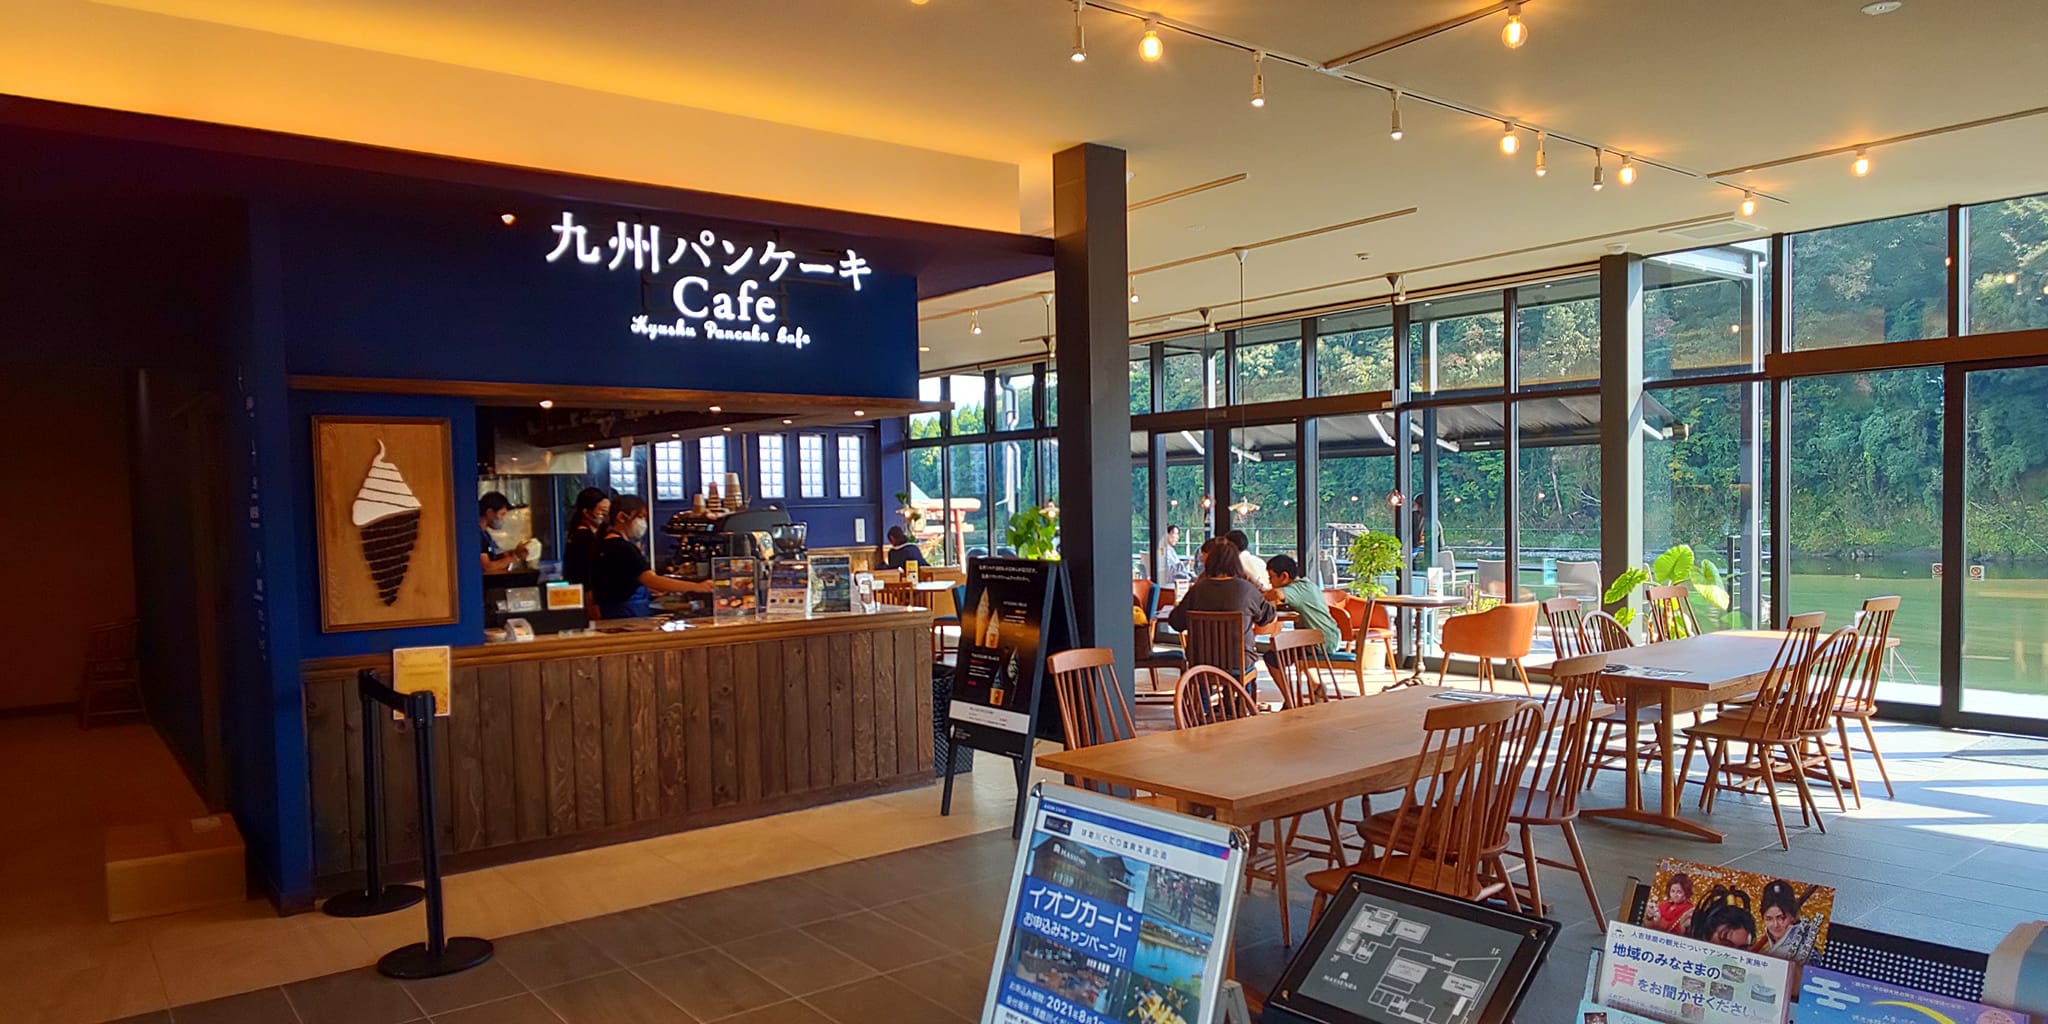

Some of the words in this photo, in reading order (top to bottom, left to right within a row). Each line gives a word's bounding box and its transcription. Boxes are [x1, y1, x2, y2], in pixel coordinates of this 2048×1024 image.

[545, 211, 872, 291] 九州パンケーキ
[672, 275, 777, 323] Cafe
[630, 314, 697, 340] Kyushu
[703, 320, 770, 343] Pancake
[776, 321, 811, 350] Cafe
[1028, 886, 1133, 938] イオンカード
[1612, 942, 1721, 980] 地域のみなさまの
[1631, 931, 1769, 968] 人吉球磨の観光についてアンケート実施中
